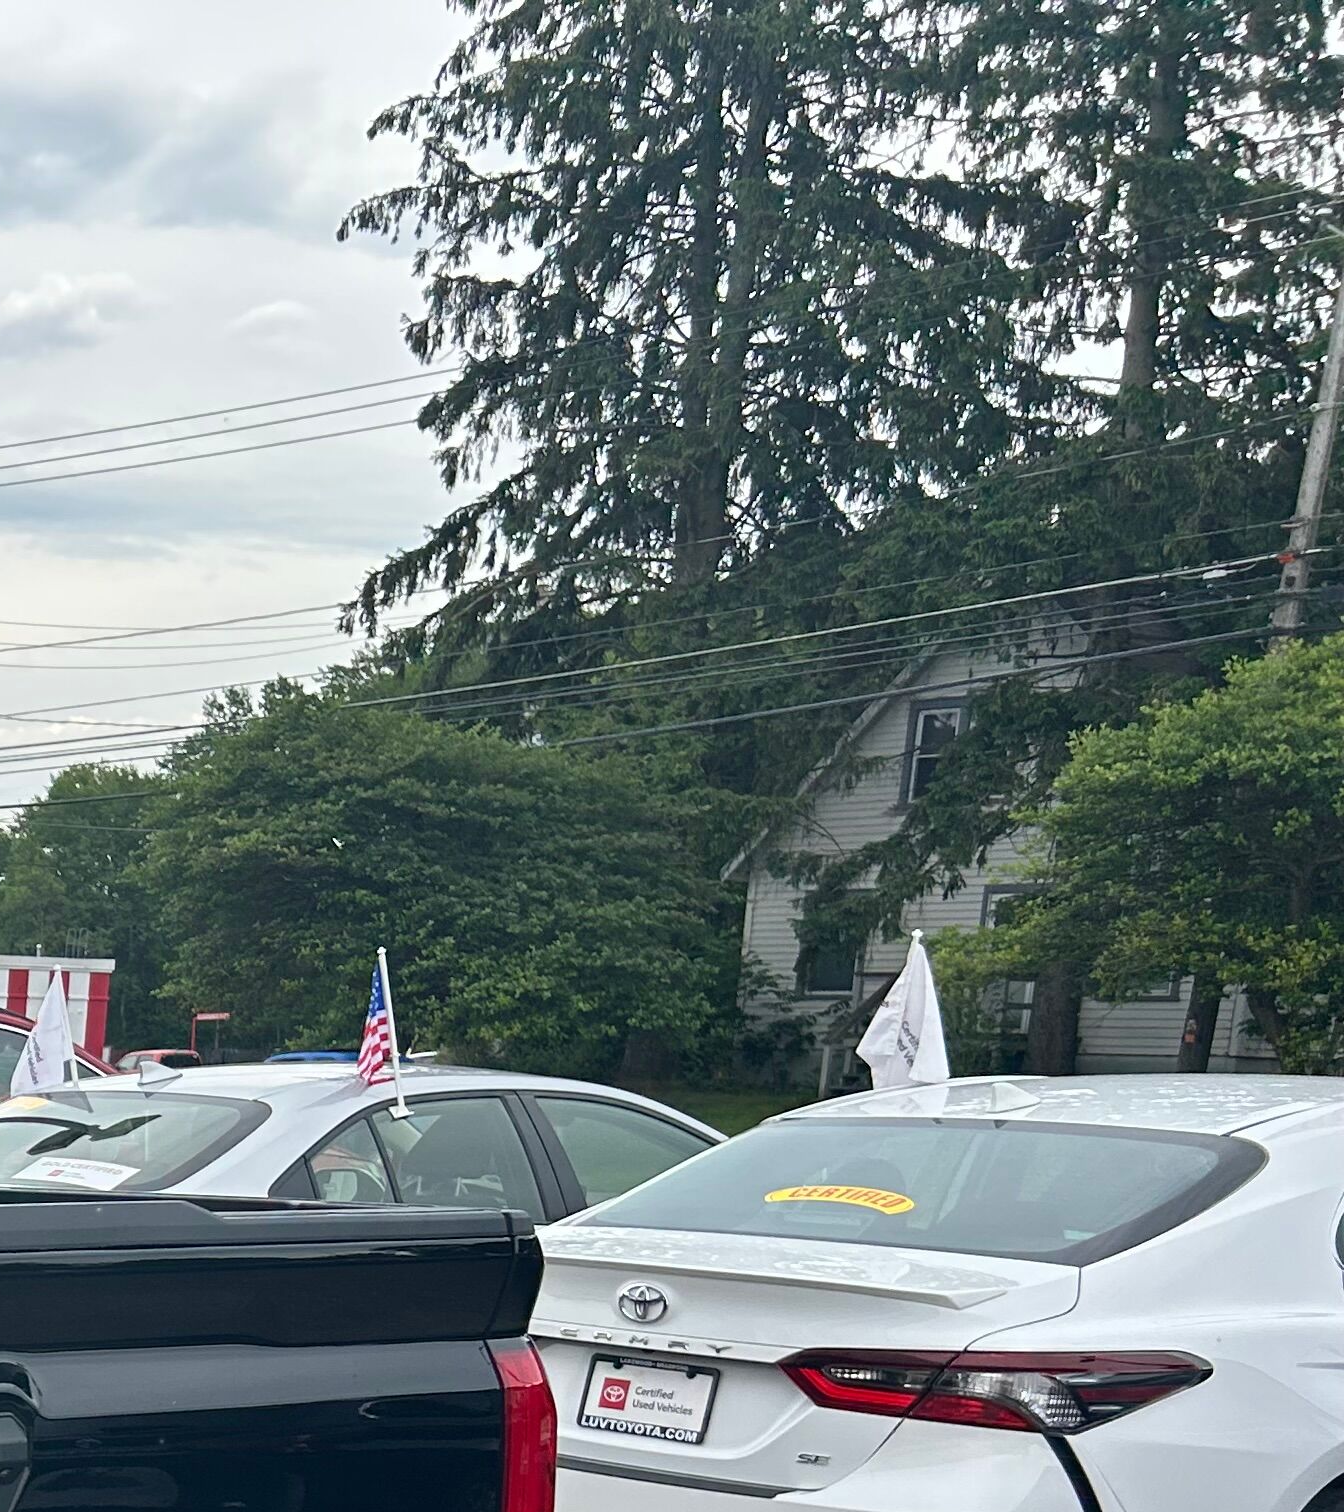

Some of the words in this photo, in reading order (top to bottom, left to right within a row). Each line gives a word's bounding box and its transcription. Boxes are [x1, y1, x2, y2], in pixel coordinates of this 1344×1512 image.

[788, 1187, 907, 1208] CERTIFIED
[559, 1326, 733, 1354] CAMRY
[635, 1386, 674, 1399] Certified
[632, 1399, 655, 1410] Used
[656, 1402, 693, 1416] Vehicles
[580, 1415, 698, 1443] LUVTOYOTA.COM
[795, 1453, 831, 1466] SE
